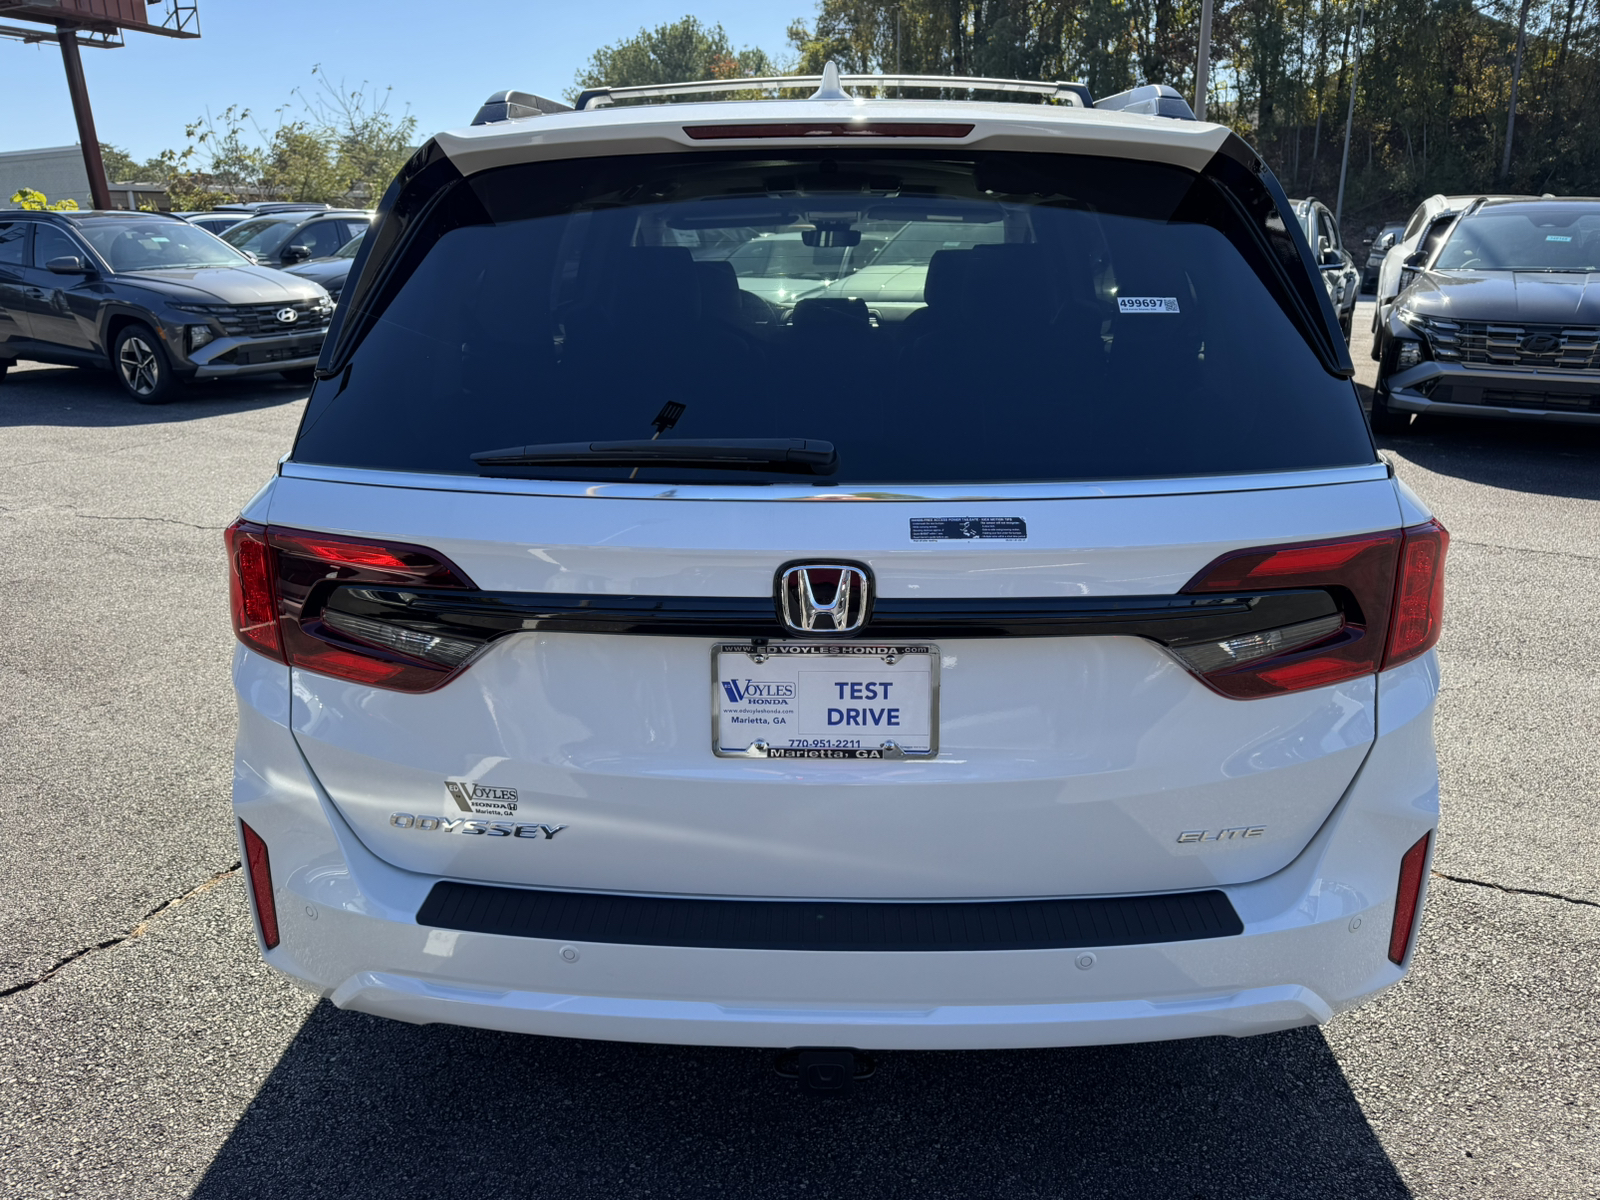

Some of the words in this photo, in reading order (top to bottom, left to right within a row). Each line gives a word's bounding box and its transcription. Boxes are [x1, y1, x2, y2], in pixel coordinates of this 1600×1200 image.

[1120, 298, 1163, 308] 499697
[834, 682, 893, 700] TEST
[731, 716, 770, 725] Marietta,
[772, 717, 787, 725] GA
[827, 708, 900, 726] DRIVE
[788, 739, 861, 748] 770-951-2211
[770, 749, 849, 758] Marietta,
[855, 750, 880, 758] GA
[448, 784, 459, 792] ED
[475, 808, 503, 816] Marietta,
[389, 811, 570, 840] ODYSSEY
[1176, 824, 1267, 843] ELITE
